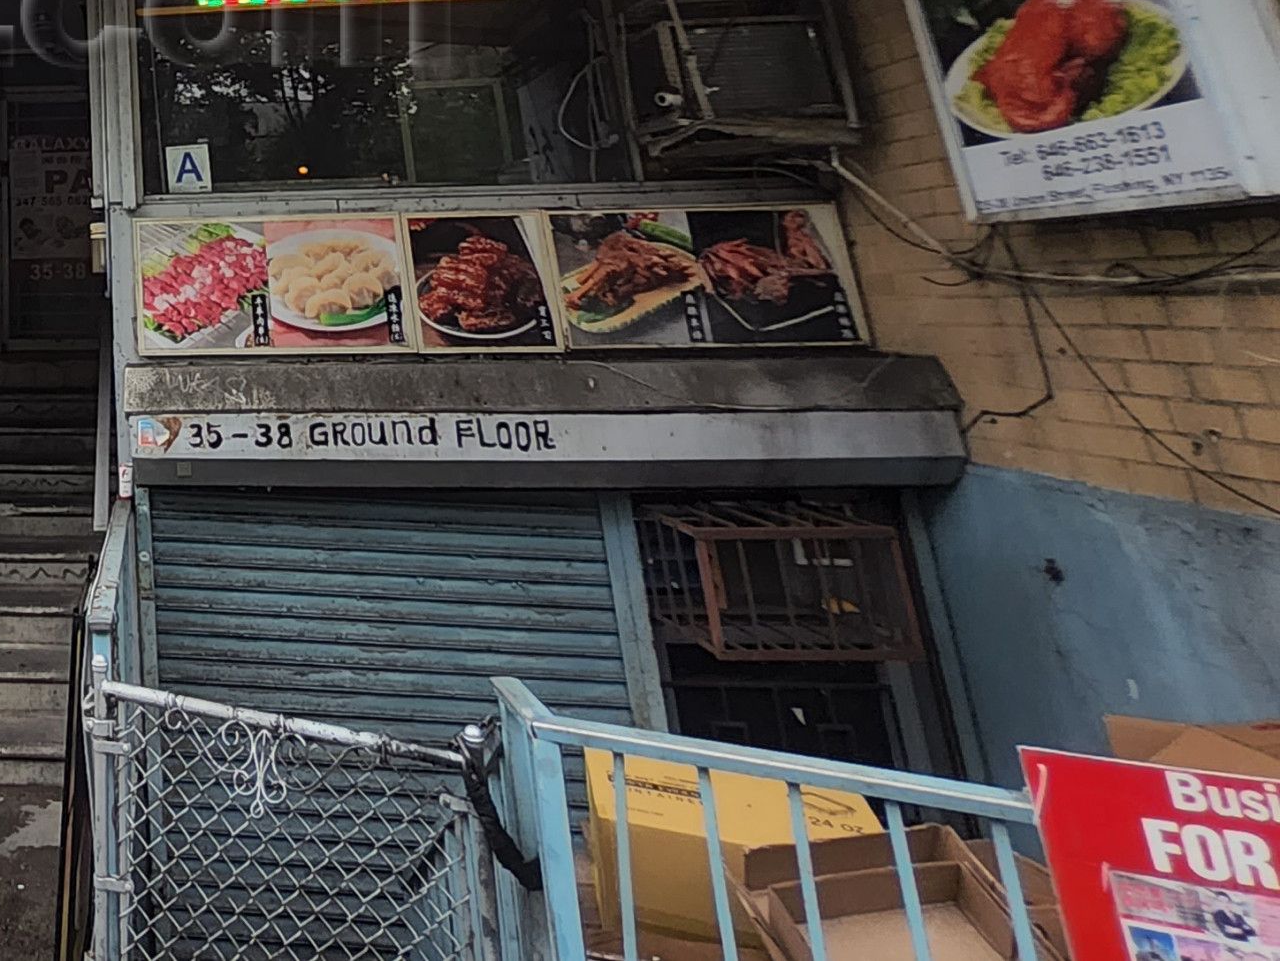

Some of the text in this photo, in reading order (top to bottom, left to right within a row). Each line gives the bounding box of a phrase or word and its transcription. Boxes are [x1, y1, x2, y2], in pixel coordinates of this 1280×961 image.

[175, 151, 204, 184] A
[456, 418, 557, 452] FLOOR
[807, 815, 834, 829] 24
[1140, 817, 1280, 891] FOR
